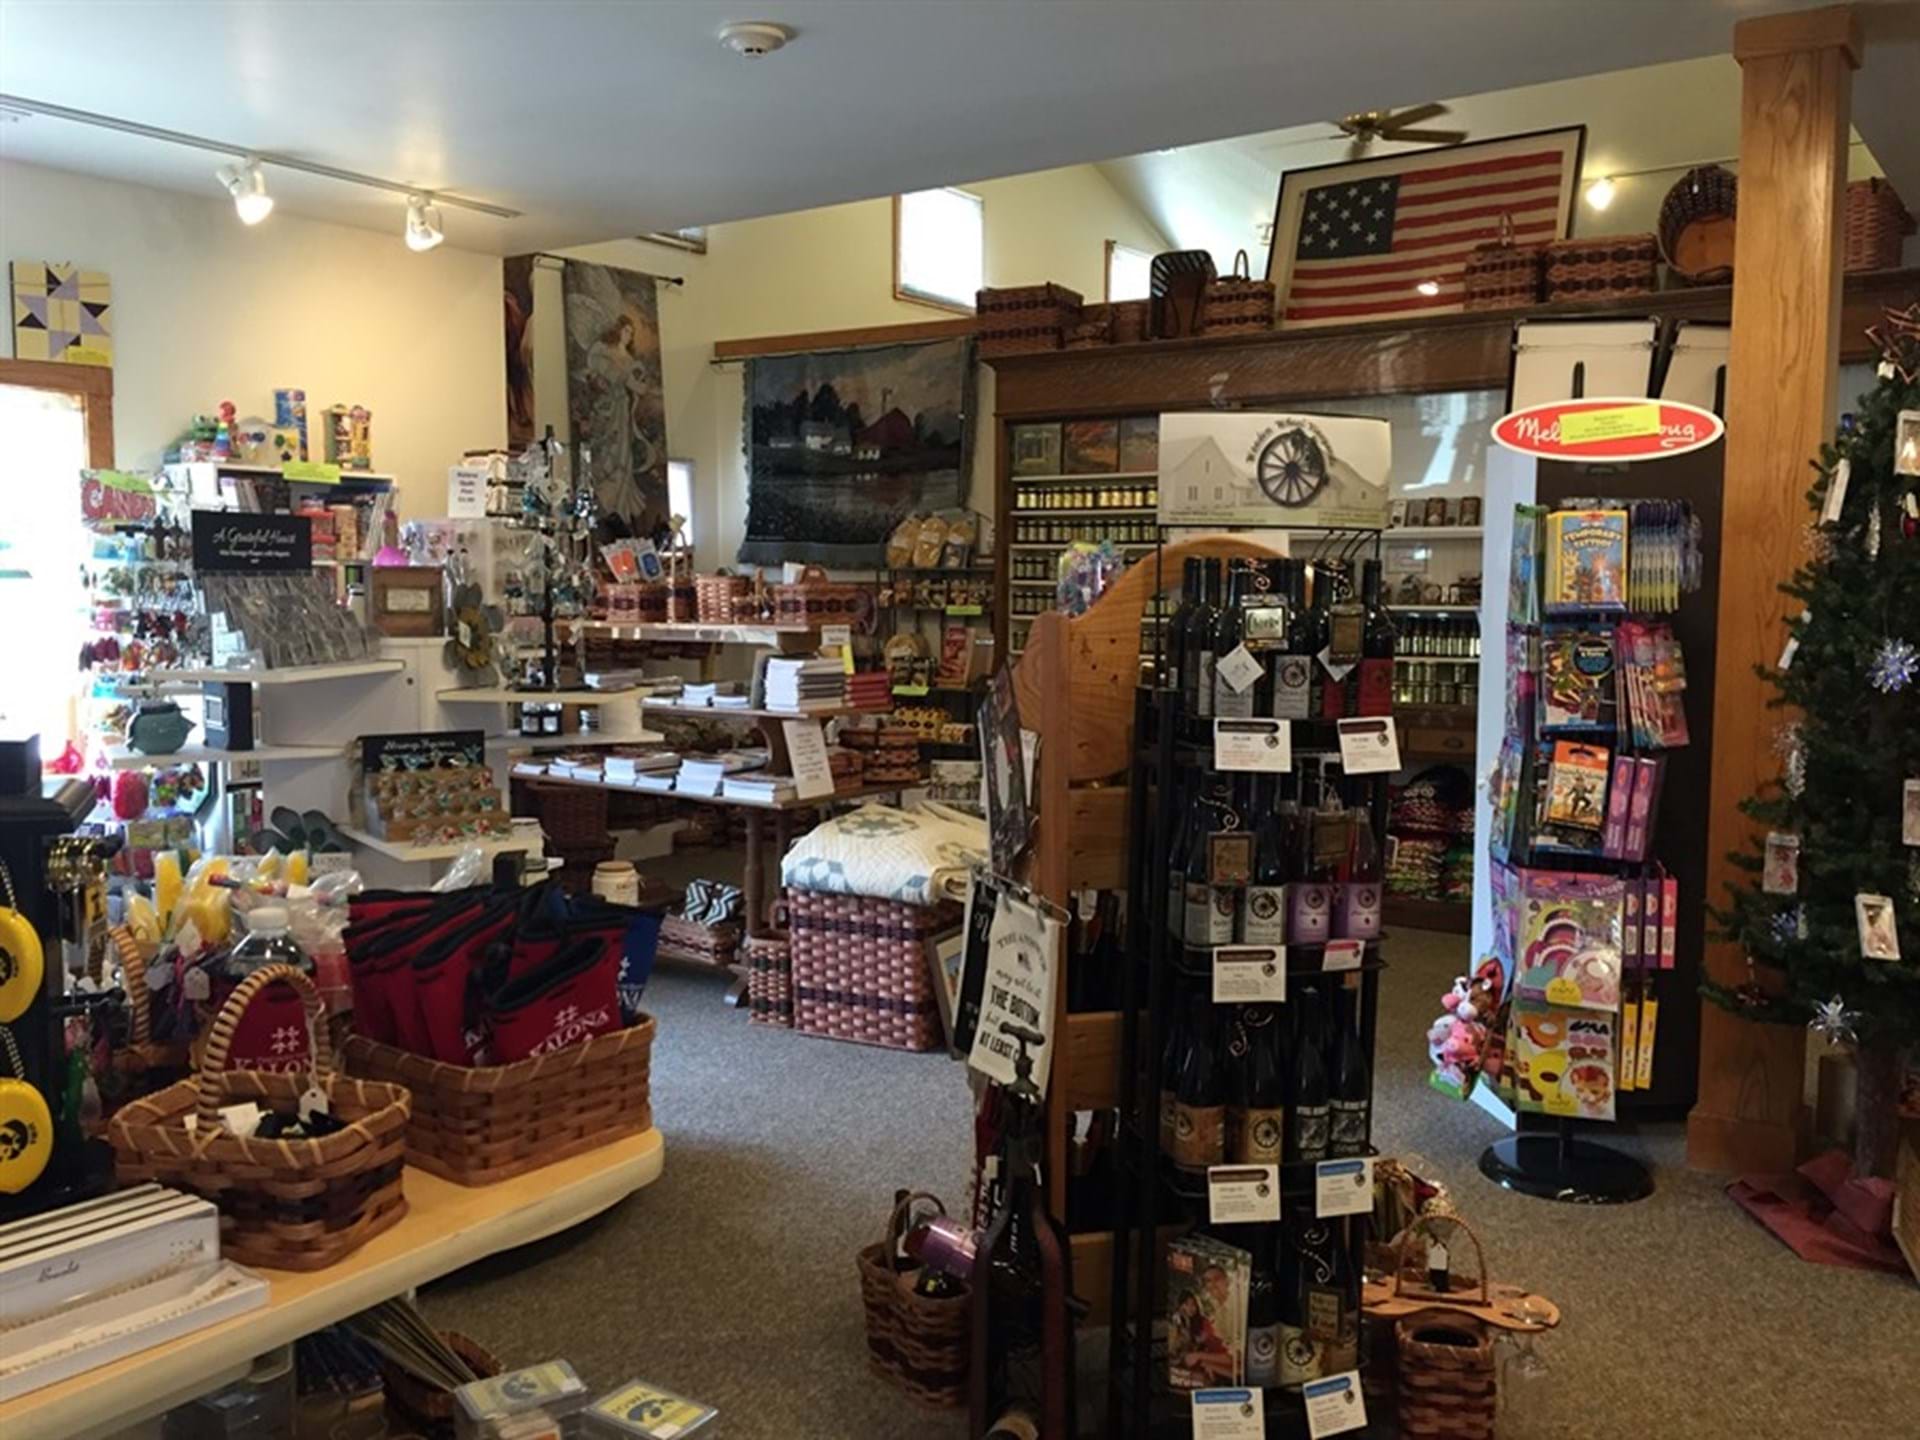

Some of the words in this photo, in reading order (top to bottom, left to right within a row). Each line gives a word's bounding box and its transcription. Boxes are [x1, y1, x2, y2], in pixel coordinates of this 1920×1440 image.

[990, 984, 1009, 1011] THE
[529, 1009, 609, 1057] KALONA
[979, 1030, 991, 1048] AT
[989, 1036, 1013, 1060] LEAST
